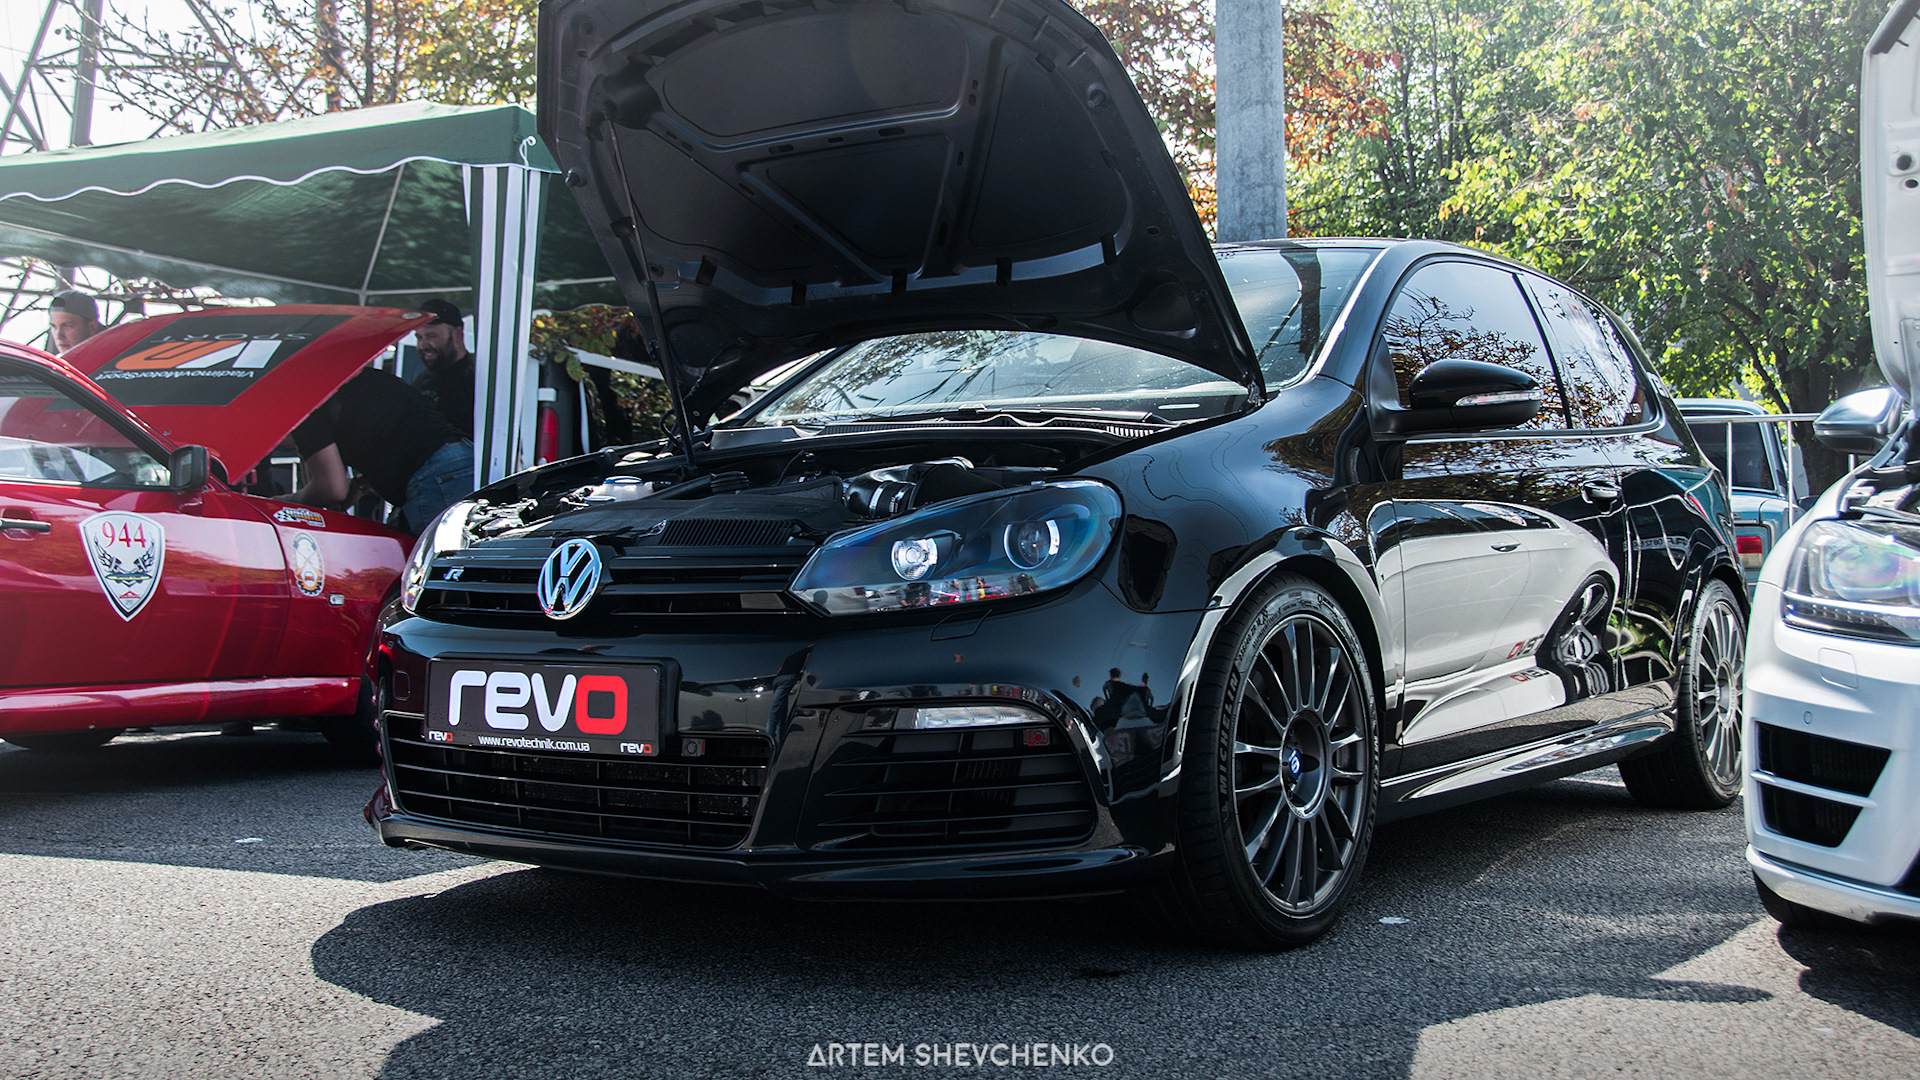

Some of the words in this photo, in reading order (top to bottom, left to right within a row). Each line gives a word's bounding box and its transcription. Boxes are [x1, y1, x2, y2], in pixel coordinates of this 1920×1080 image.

[150, 333, 312, 343] SPORT
[102, 520, 147, 548] 944
[449, 670, 628, 735] revo
[428, 731, 454, 742] revo
[478, 735, 590, 752] www.revotechnik.com.ua
[1218, 676, 1240, 796] MICHELIN
[620, 742, 652, 754] revo
